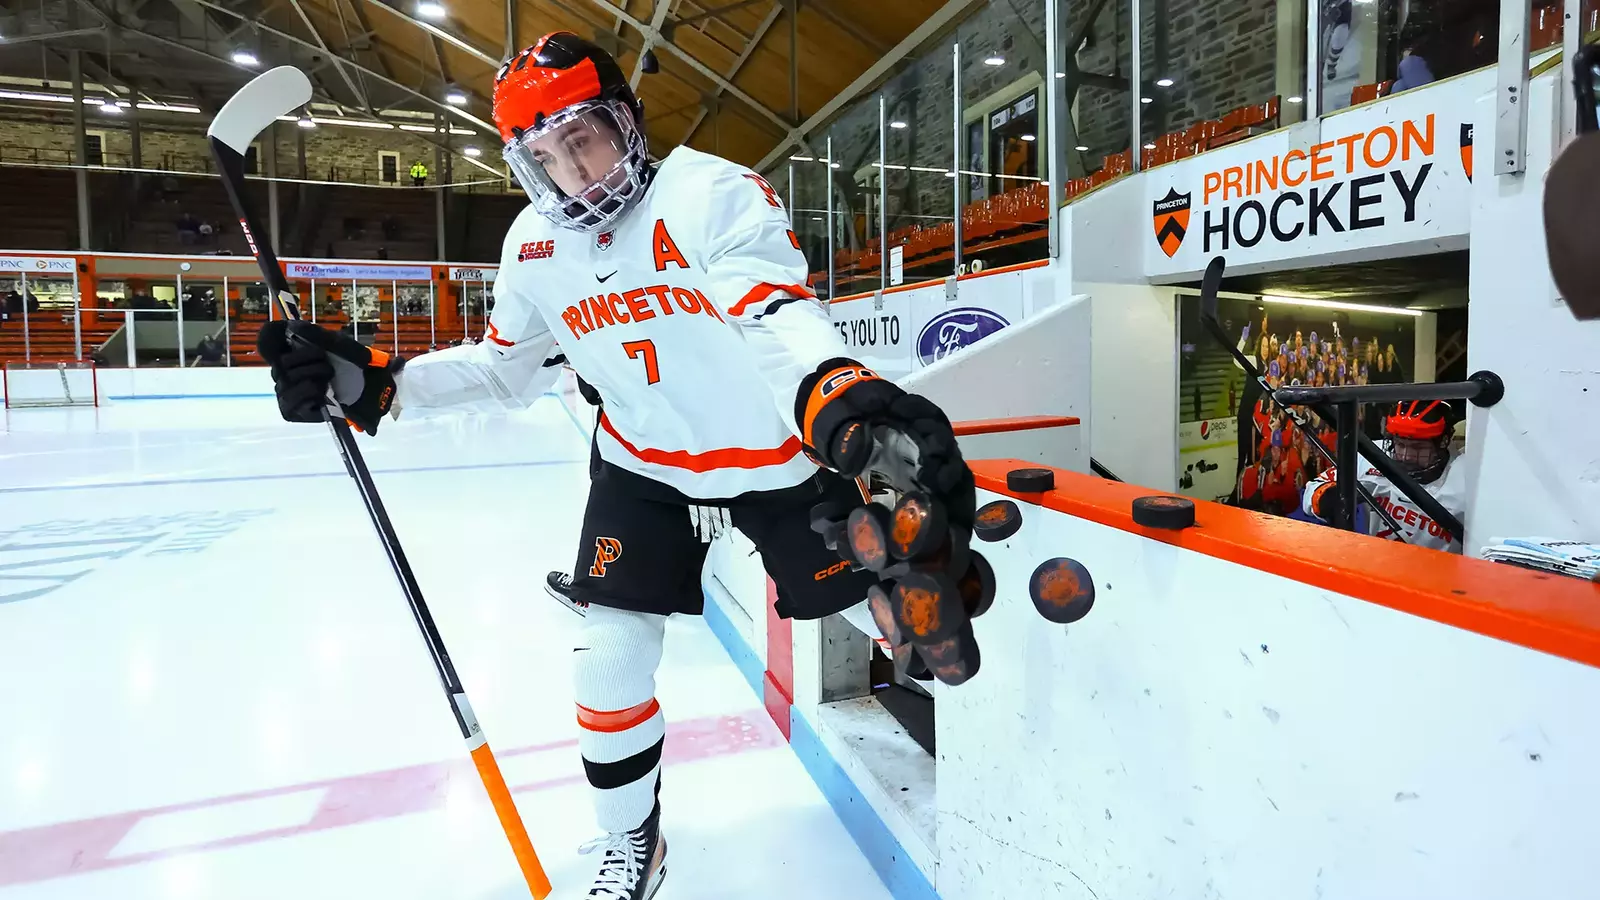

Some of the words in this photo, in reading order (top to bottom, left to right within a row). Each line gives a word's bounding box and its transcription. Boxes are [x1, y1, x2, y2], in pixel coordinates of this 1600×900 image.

[1203, 113, 1435, 206] PRINCETON
[1156, 197, 1188, 211] PRINCETON
[1203, 162, 1434, 253] HOCKEY
[0, 260, 24, 268] PNC
[49, 261, 72, 269] PNC
[520, 239, 555, 254] ECAC
[652, 218, 691, 272] A
[560, 284, 727, 341] PRINCETON
[850, 318, 877, 347] YOU
[880, 314, 900, 346] TO
[621, 338, 661, 386] 7
[589, 536, 623, 578] P
